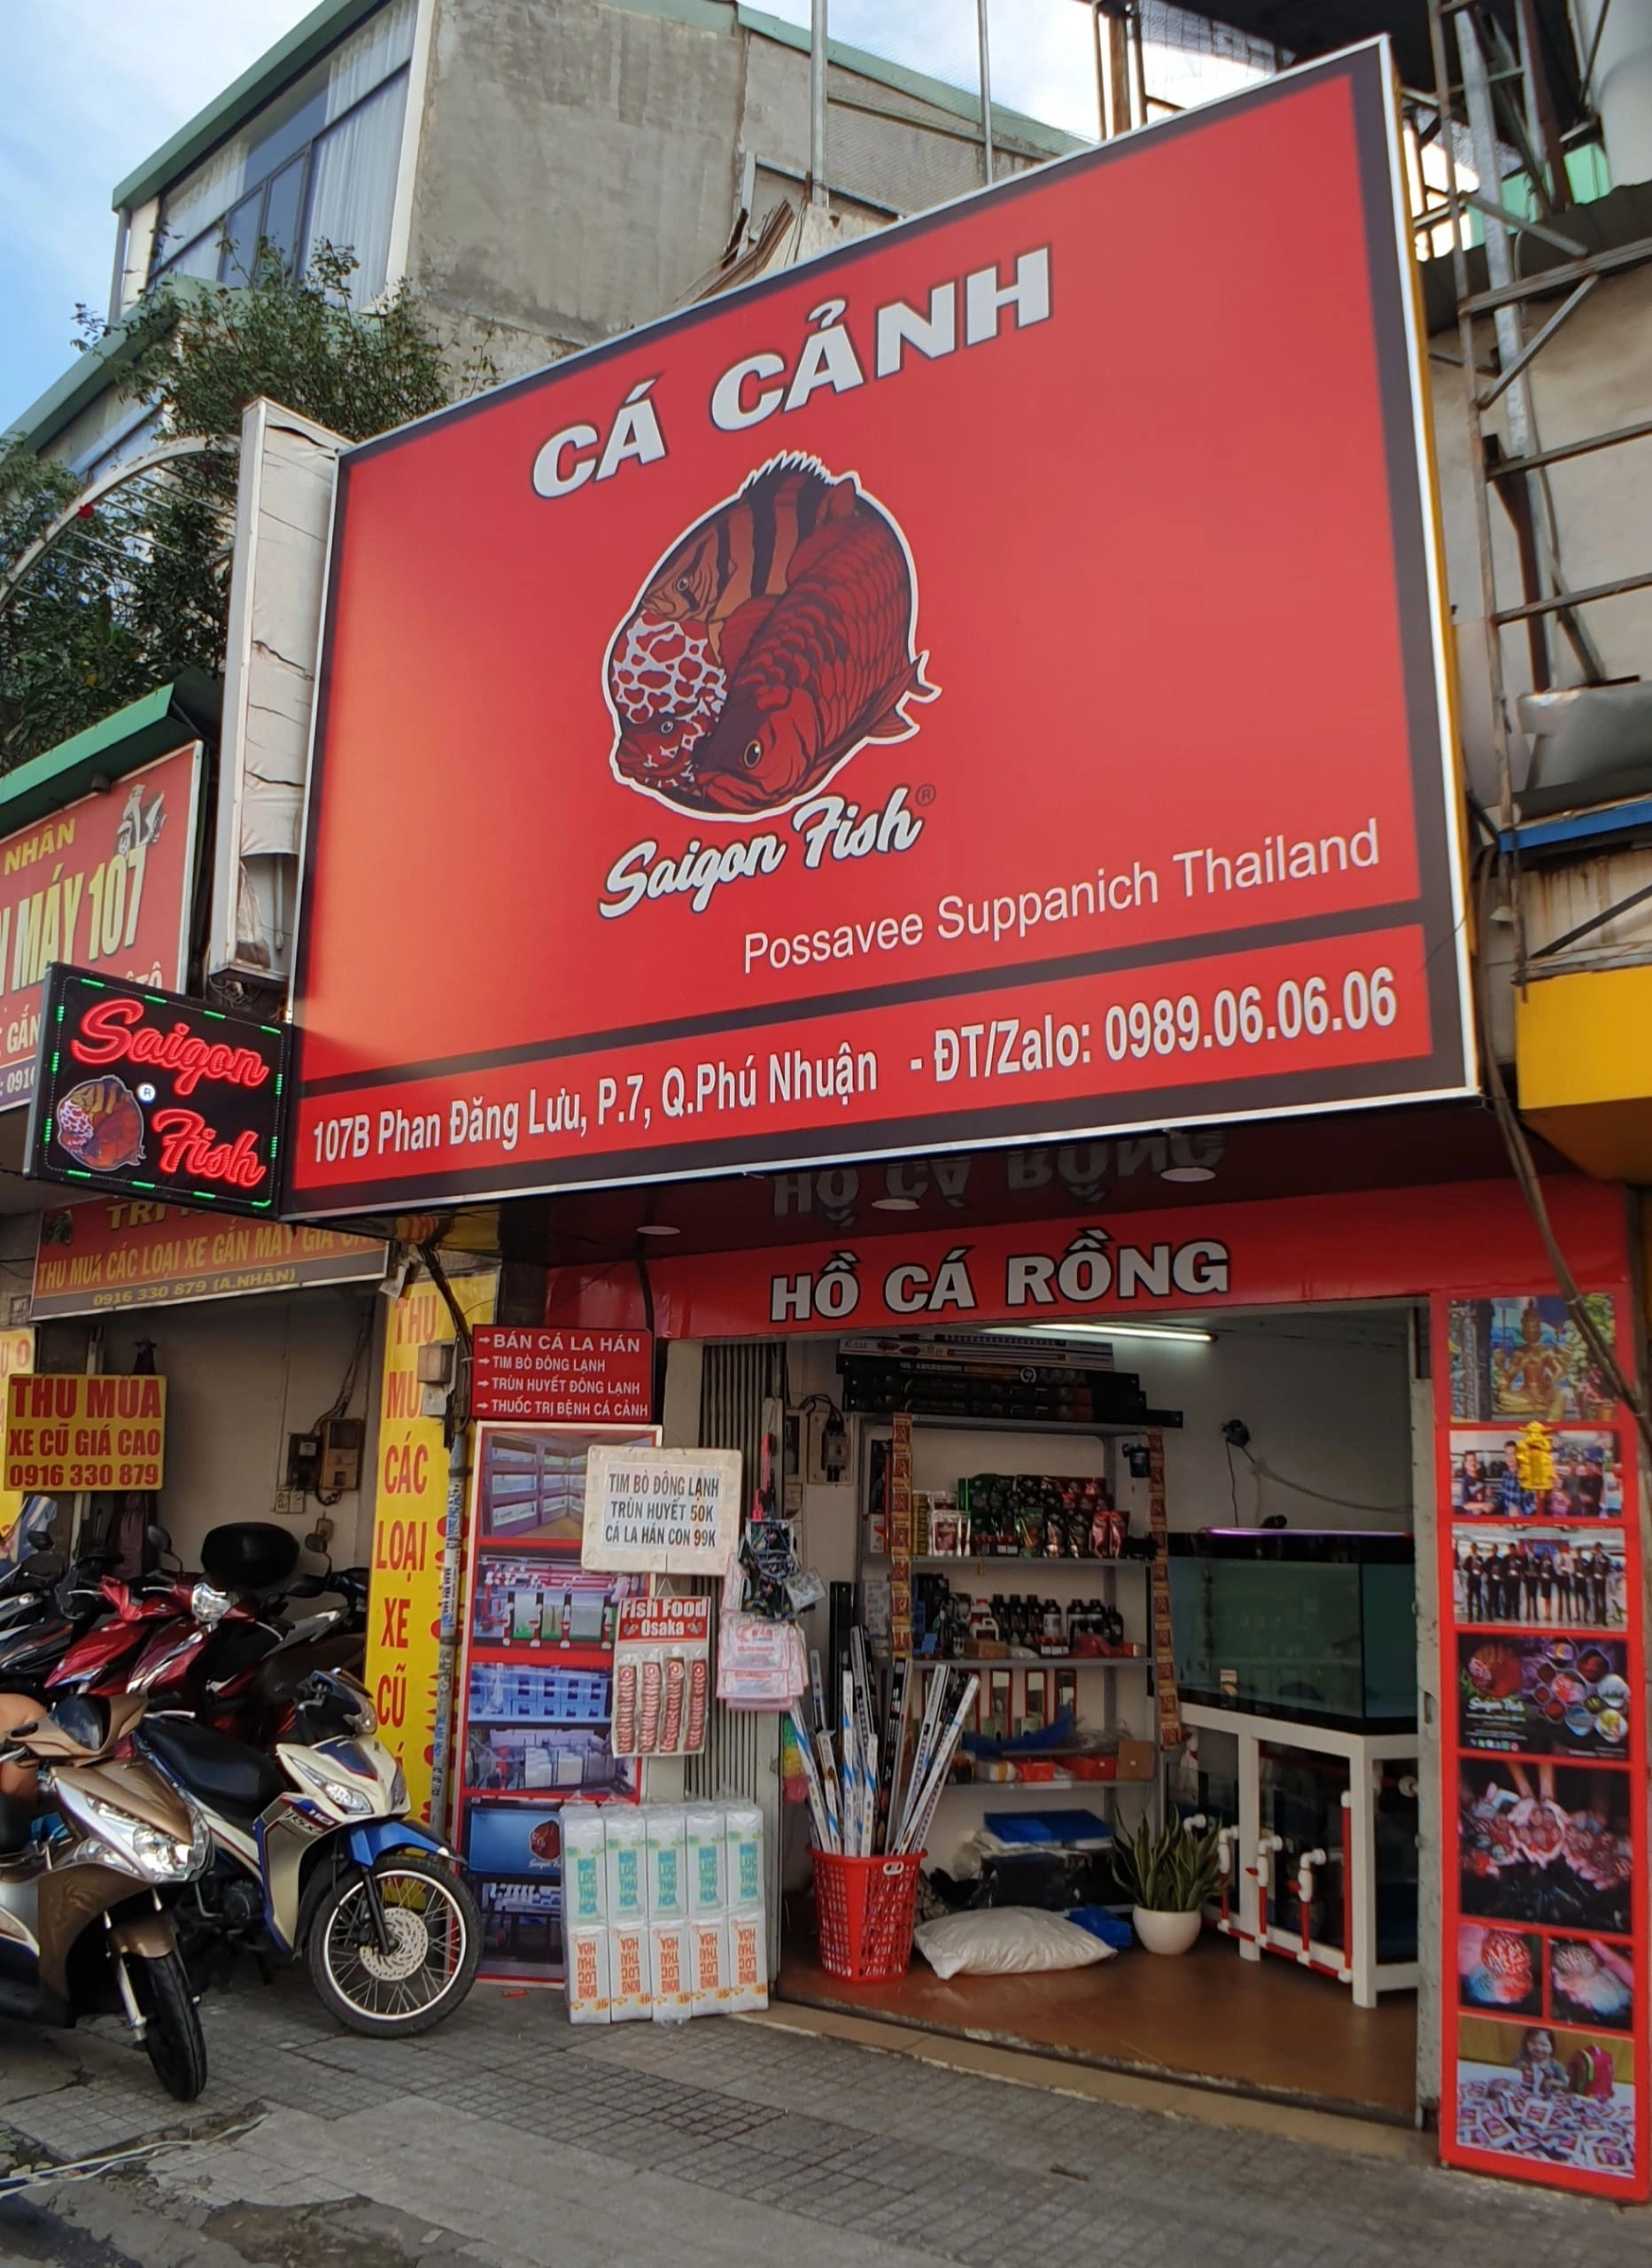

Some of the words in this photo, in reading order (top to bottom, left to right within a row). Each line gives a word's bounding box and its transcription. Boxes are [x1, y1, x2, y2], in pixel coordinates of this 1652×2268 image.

[532, 378, 666, 498] CÁ
[711, 246, 1050, 431] CẢNH
[4, 818, 75, 875] NHÂN
[599, 834, 786, 918] Saigon
[793, 787, 923, 867] Fish
[12, 863, 84, 991] MÁY
[89, 846, 146, 961] 107
[744, 912, 923, 974] Possavee
[937, 862, 1158, 941] Suppanich
[1173, 818, 1379, 897] Thailand
[71, 998, 269, 1095] Saigon
[313, 1117, 369, 1163] 107B
[378, 1107, 440, 1154] Phan
[449, 1095, 519, 1150] Đăng
[529, 1088, 587, 1138] Lưu,
[598, 1075, 651, 1130] P.7,
[662, 1055, 756, 1118] Q.Phú
[769, 1042, 877, 1106] Nhuận
[935, 1014, 1090, 1083] ĐT/Zalo:
[1105, 967, 1397, 1061] 0989.06.06.06
[151, 1109, 266, 1189] Fish
[38, 1259, 66, 1291] THU
[69, 1254, 101, 1285] MUA
[105, 1241, 138, 1280] CÁC
[142, 1239, 181, 1278] LOẠI
[184, 1236, 207, 1270] XE
[212, 1217, 249, 1264] GẮN
[771, 1251, 859, 1321] HỒ
[885, 1247, 975, 1314] CÁ
[1006, 1228, 1229, 1306] RỒNG
[93, 1291, 132, 1306] 0916
[136, 1285, 167, 1301] 330
[173, 1280, 206, 1295] 879
[213, 1268, 296, 1291] (A.NHÂN)
[395, 1294, 437, 1345] THU
[493, 1331, 531, 1349] BÁN
[538, 1332, 563, 1350] CÁ
[570, 1336, 593, 1351] LA
[600, 1333, 640, 1352] HÁN
[492, 1355, 512, 1369] TIM
[515, 1354, 532, 1370] BÒ
[535, 1355, 570, 1371] ĐÔNG
[573, 1359, 605, 1373] LẠNH
[492, 1375, 524, 1391] TRÙN
[527, 1374, 566, 1393] HUYẾT
[570, 1377, 604, 1394] ĐÔNG
[607, 1381, 640, 1396] LẠNH
[12, 1379, 78, 1418] THU
[86, 1379, 162, 1418] MUA
[386, 1371, 422, 1418] MU
[492, 1395, 531, 1413] THUỐC
[535, 1401, 554, 1417] TRỊ
[557, 1399, 590, 1417] BỆNH
[593, 1401, 610, 1416] CÁ
[614, 1399, 648, 1417] CẢNH
[9, 1428, 34, 1456] XE
[39, 1423, 69, 1456] CŨ
[74, 1424, 112, 1456] GIÁ
[117, 1428, 161, 1456] CAO
[384, 1432, 429, 1495] CÁC
[10, 1464, 64, 1487] 0916
[70, 1464, 112, 1486] 330
[119, 1464, 159, 1486] 879
[609, 1473, 630, 1493] TIM
[633, 1470, 649, 1495] BÒ
[653, 1471, 685, 1495] ĐÔNG
[688, 1476, 719, 1501] LẠNH
[605, 1521, 620, 1542] CÁ
[624, 1525, 638, 1543] LA
[641, 1522, 665, 1545] HÁN
[668, 1527, 690, 1545] CON
[694, 1528, 717, 1548] 99K
[611, 1497, 643, 1518] TRÙN
[647, 1497, 686, 1520] HUYẾT
[690, 1505, 714, 1522] 50K
[376, 1519, 426, 1581] LOẠI
[381, 1597, 408, 1648] XE
[621, 1598, 658, 1619] Fish
[663, 1598, 708, 1618] Food
[640, 1619, 685, 1637] Osaka
[377, 1663, 407, 1728] CŨ
